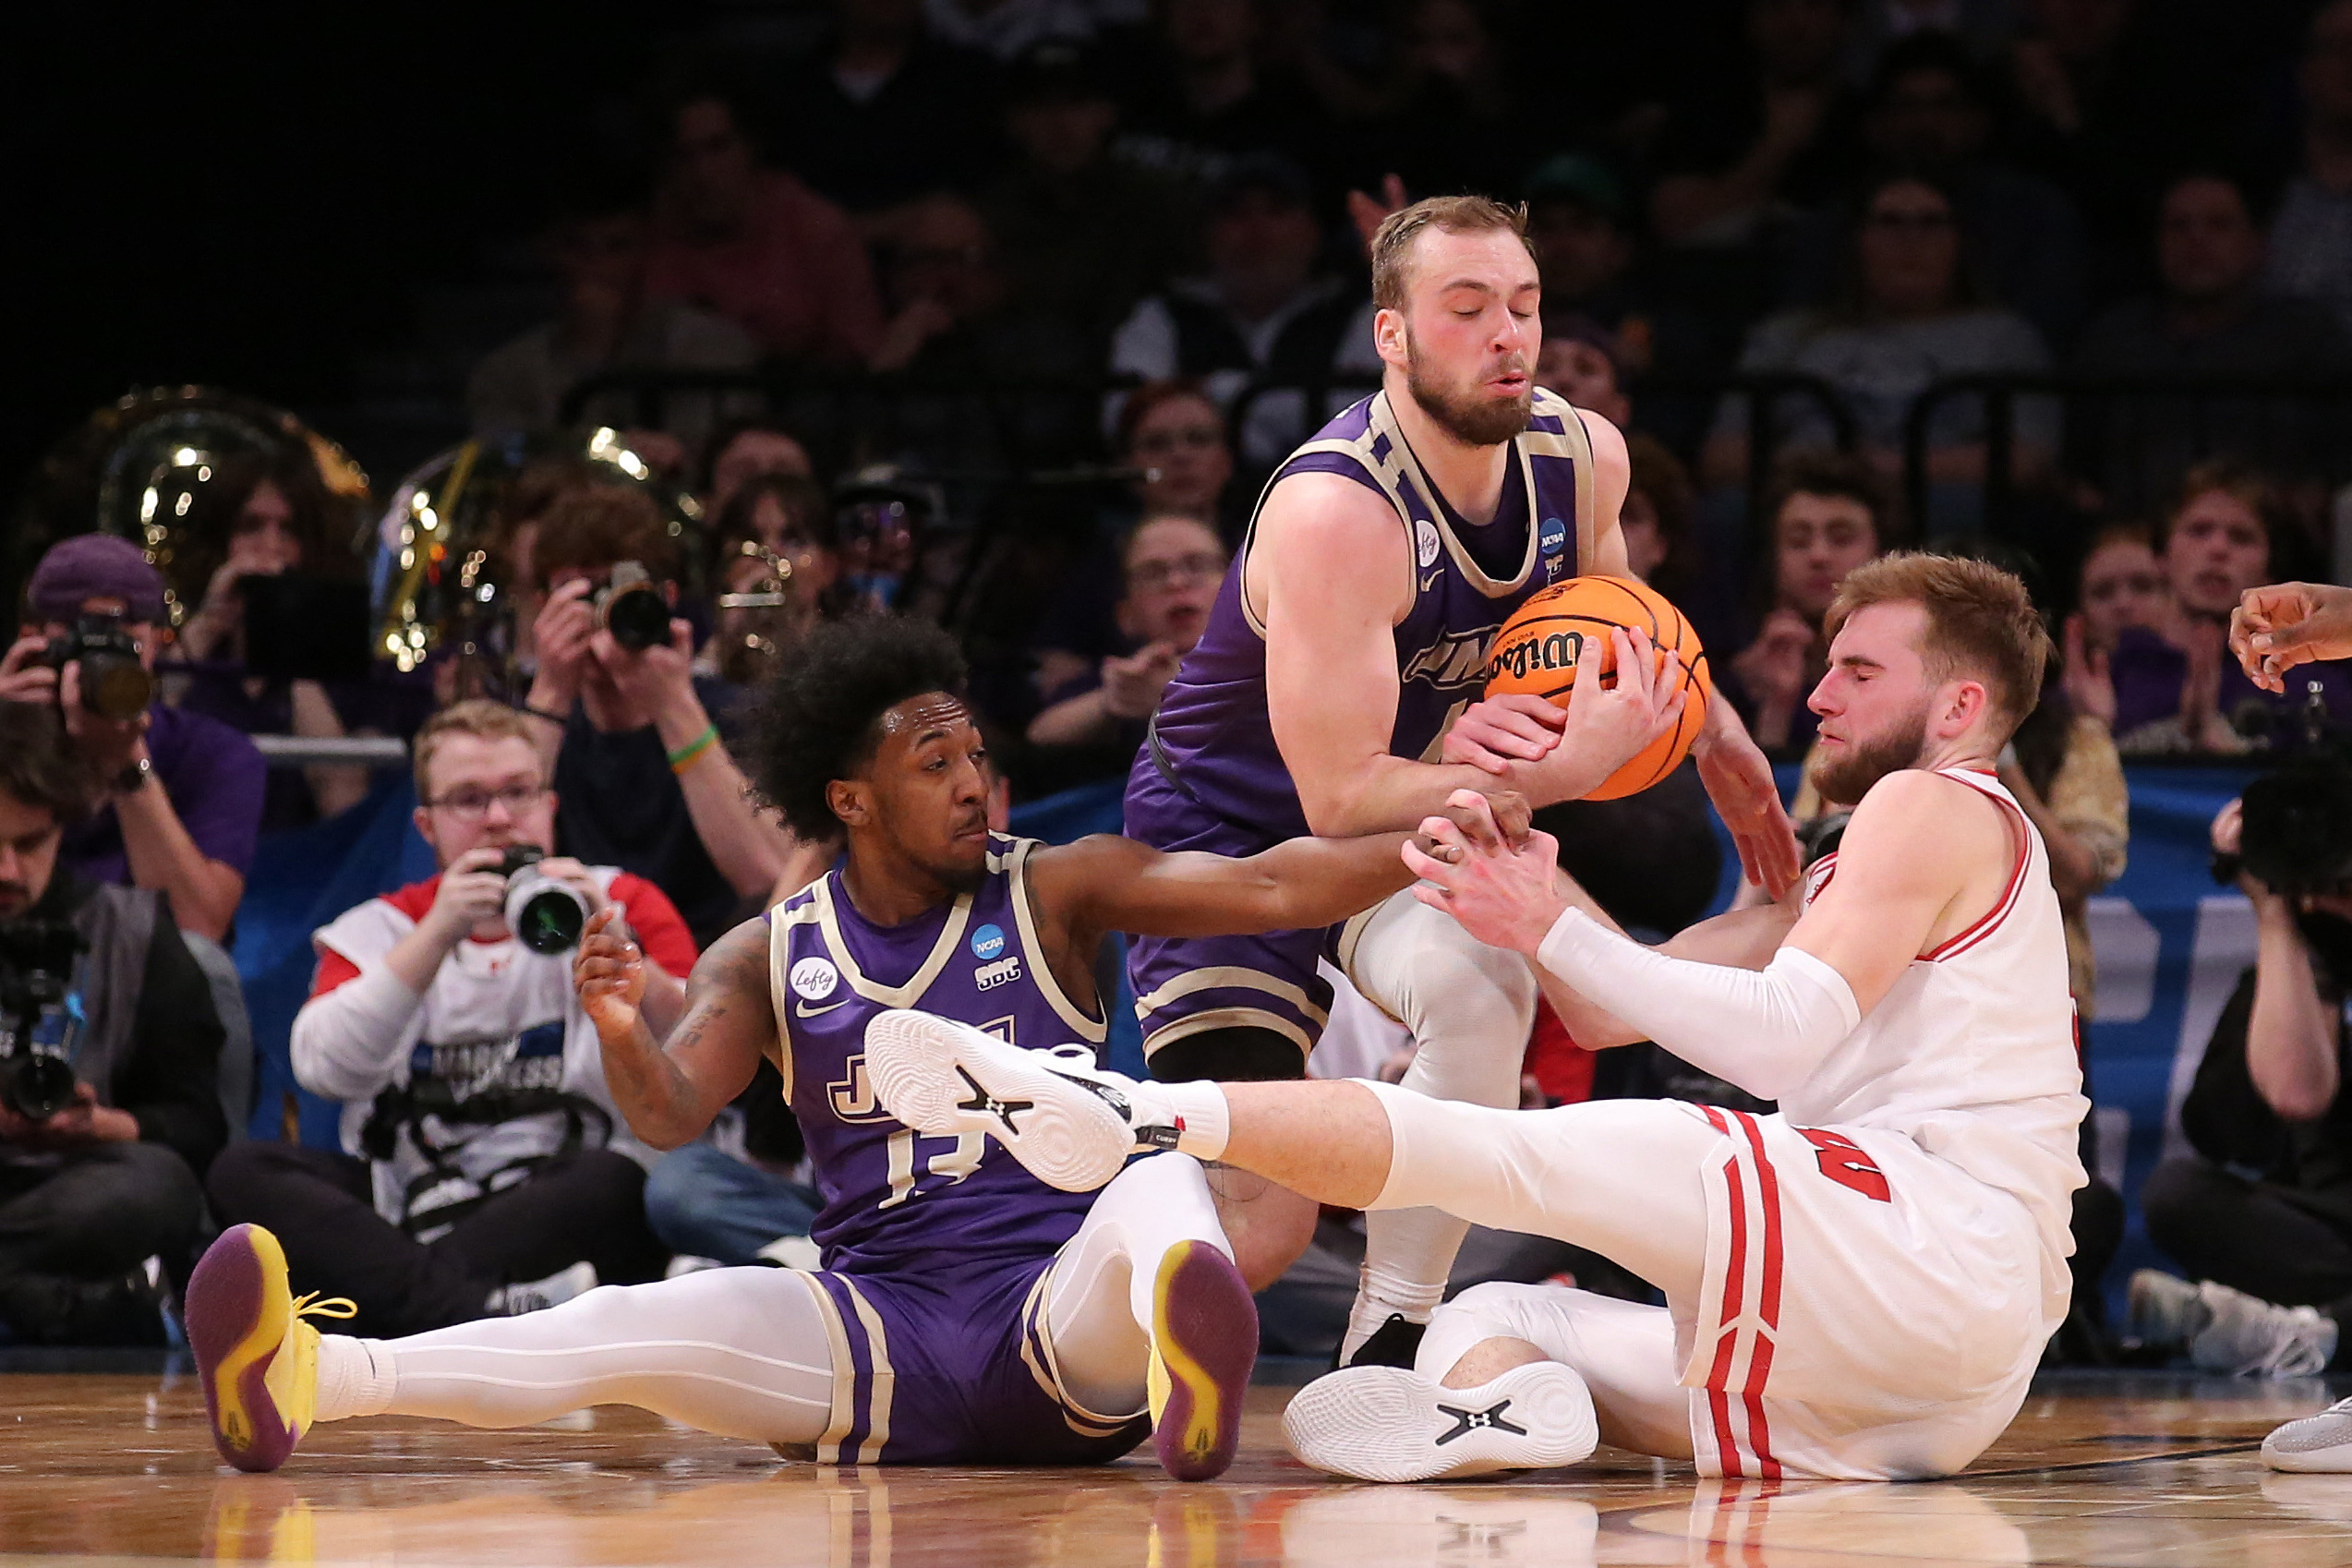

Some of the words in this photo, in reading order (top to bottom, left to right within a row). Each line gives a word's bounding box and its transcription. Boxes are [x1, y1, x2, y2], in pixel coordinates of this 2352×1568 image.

[1541, 532, 1564, 548] NCAA
[976, 936, 1005, 953] NCAA
[795, 969, 834, 992] Lefty
